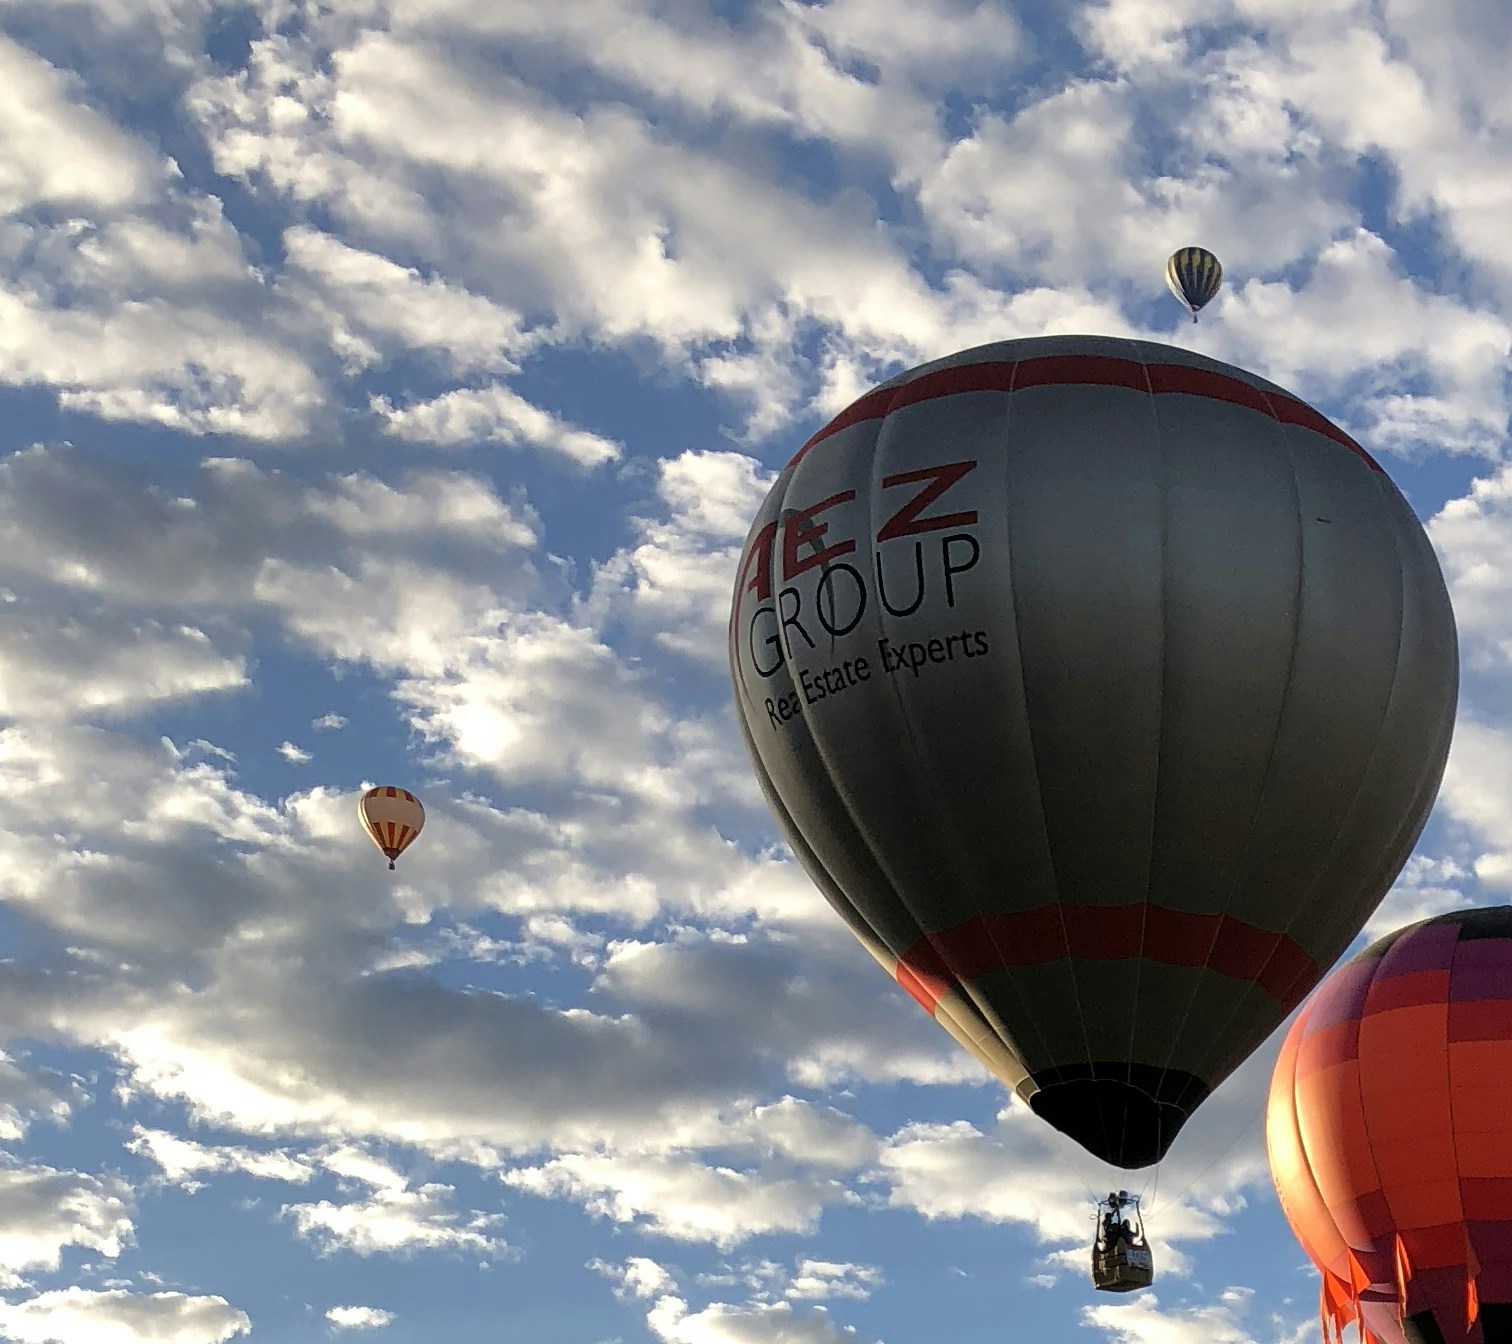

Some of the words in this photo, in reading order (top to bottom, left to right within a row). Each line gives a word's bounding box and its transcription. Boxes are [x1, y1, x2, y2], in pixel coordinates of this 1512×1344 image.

[750, 533, 979, 677] GROUP
[764, 691, 801, 731] Rea
[799, 656, 871, 704] Estate
[877, 630, 989, 678] Experts
